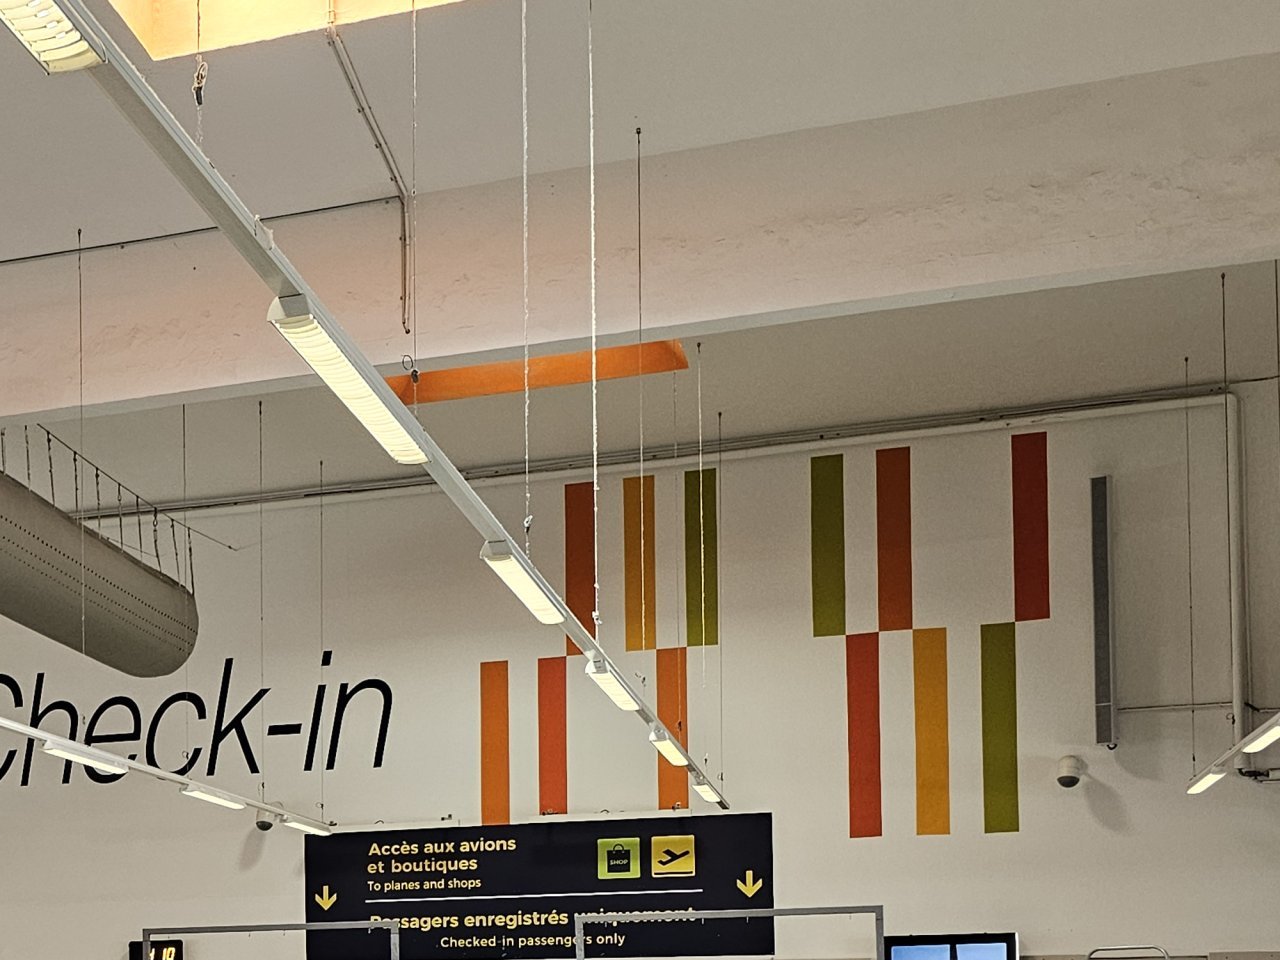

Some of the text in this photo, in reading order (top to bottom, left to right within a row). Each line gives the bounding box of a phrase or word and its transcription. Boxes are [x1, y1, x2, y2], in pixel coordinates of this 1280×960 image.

[368, 837, 516, 856] Accès aux avions
[367, 857, 478, 874] et boutiques
[368, 877, 482, 892] To planes and shops
[370, 915, 459, 932] Psagers
[464, 909, 569, 929] enregistrés
[519, 936, 593, 948] passengs
[596, 932, 625, 946] only
